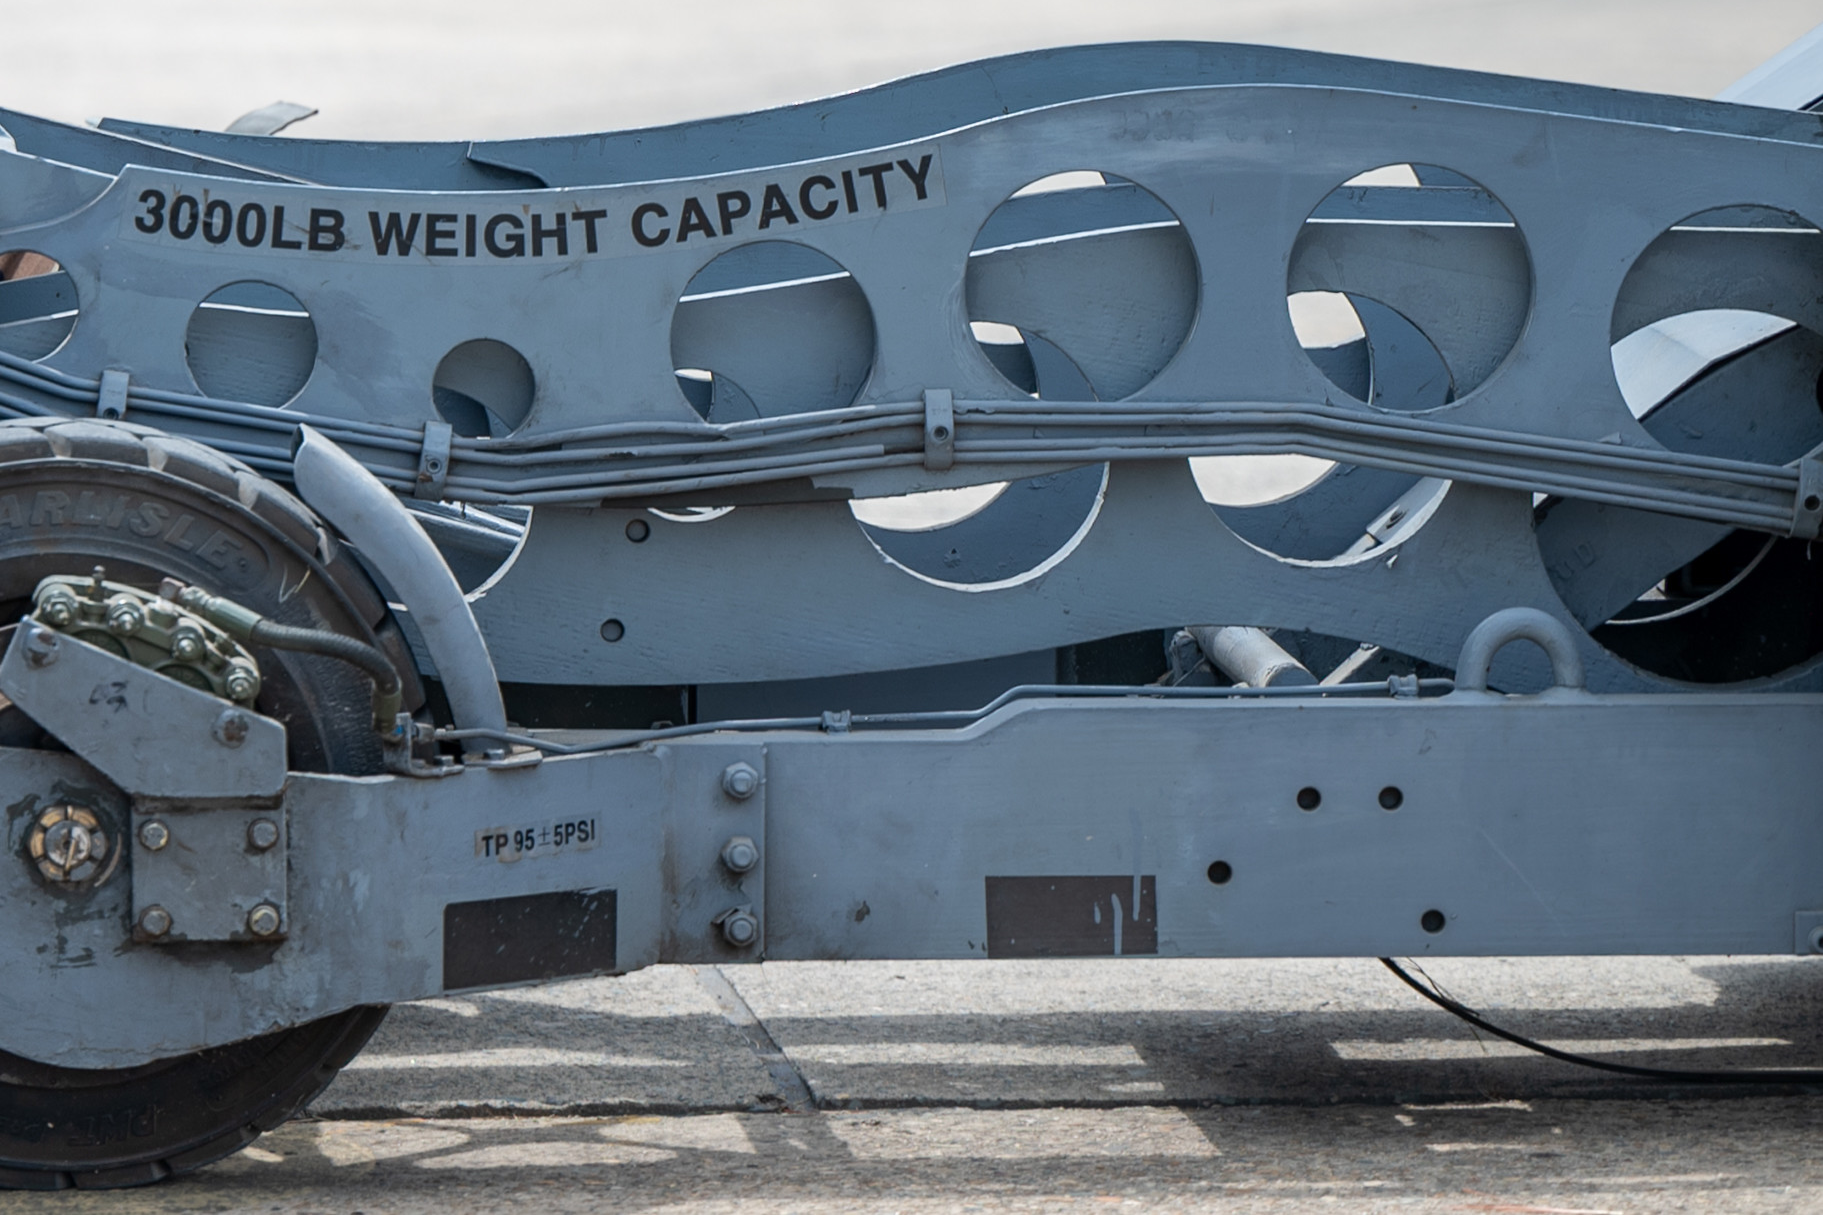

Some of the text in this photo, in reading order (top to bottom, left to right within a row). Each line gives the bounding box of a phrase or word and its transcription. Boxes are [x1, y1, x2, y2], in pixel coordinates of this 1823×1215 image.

[134, 154, 933, 258] 3000LB WEIGHT CAPACITY
[481, 833, 509, 858] TP
